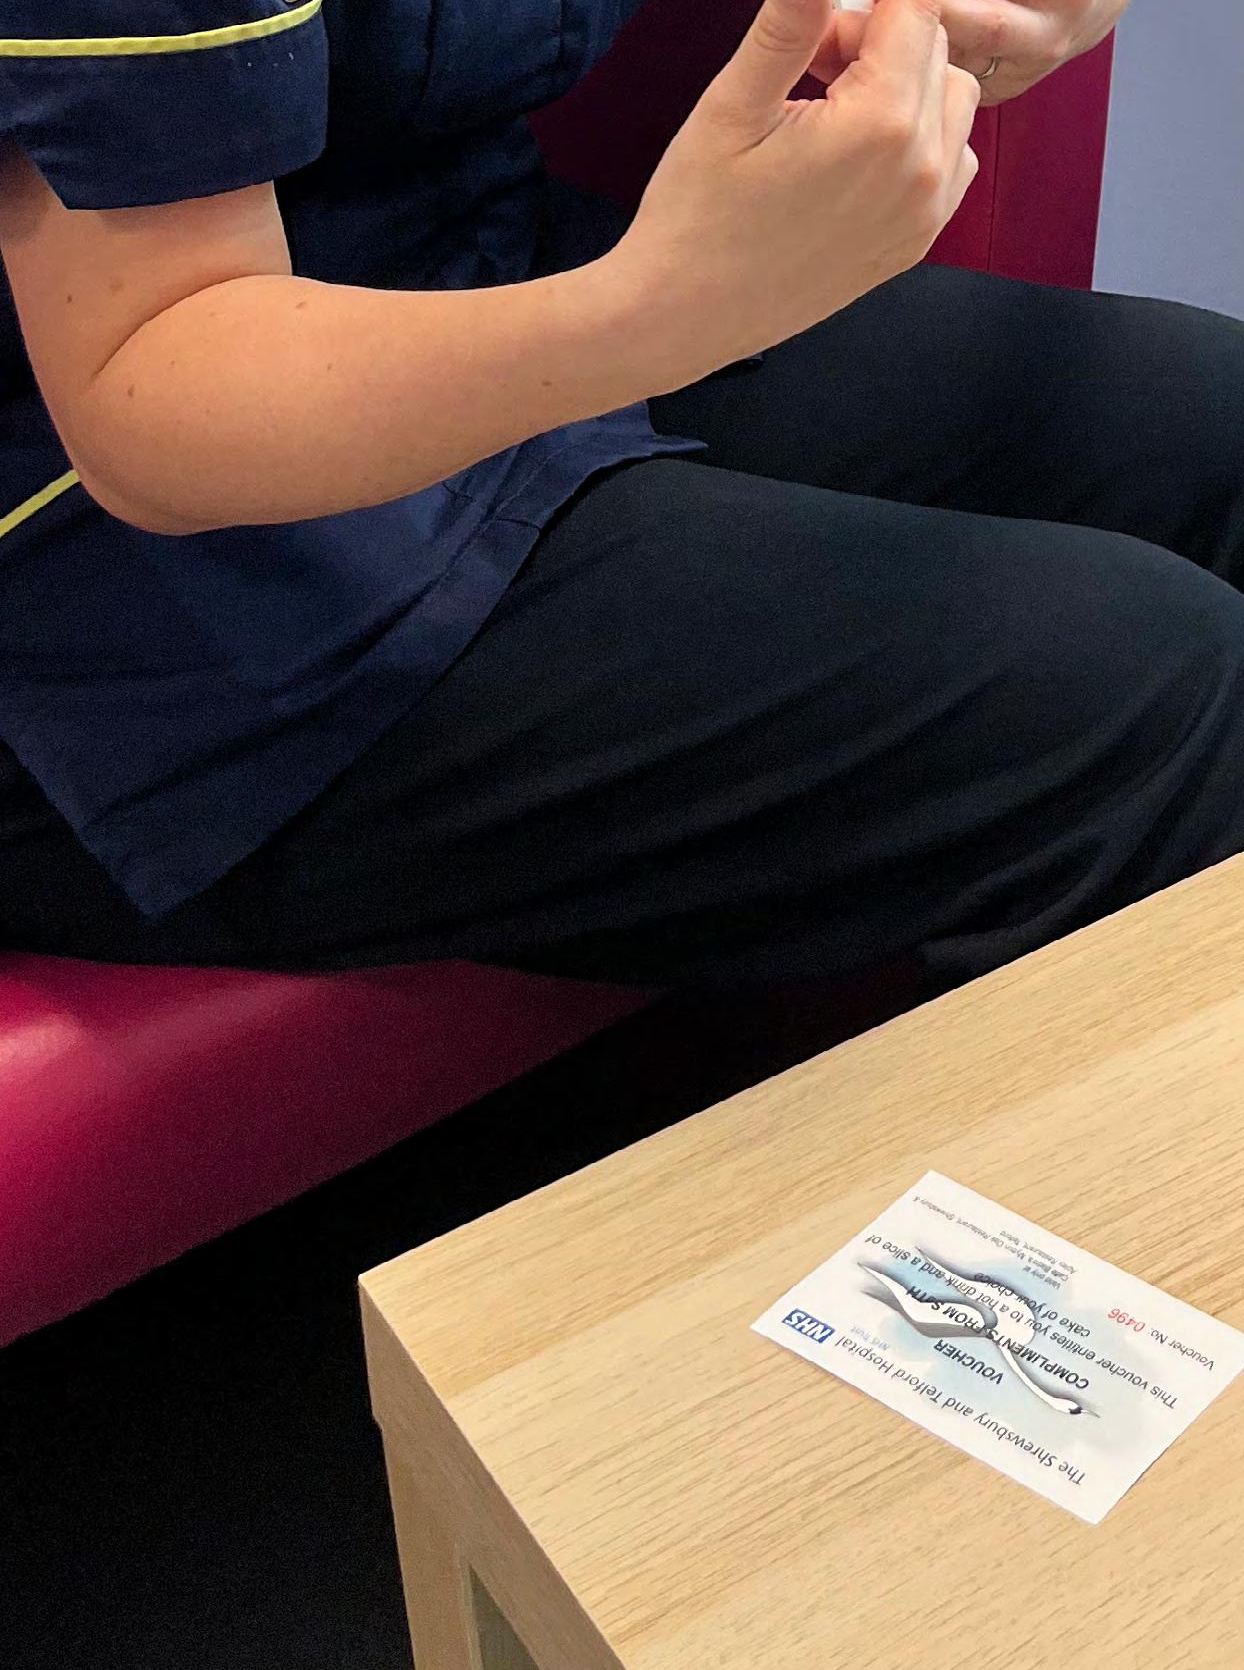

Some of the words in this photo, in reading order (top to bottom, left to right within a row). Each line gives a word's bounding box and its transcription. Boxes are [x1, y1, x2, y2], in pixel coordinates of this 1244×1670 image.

[862, 1231, 884, 1248] of
[878, 1240, 912, 1264] slice
[908, 1255, 923, 1267] a
[917, 1260, 948, 1283] and
[941, 1274, 978, 1299] drink
[969, 1269, 1017, 1300] choice
[972, 1290, 1000, 1311] hot
[996, 1302, 1012, 1315] a
[1012, 1289, 1048, 1314] your
[782, 1307, 835, 1344] NHS
[941, 1303, 988, 1334] FROM
[1006, 1307, 1027, 1324] to
[1022, 1313, 1054, 1336] you
[1039, 1307, 1060, 1324] of
[1054, 1314, 1093, 1341] cake
[1105, 1305, 1148, 1334] 0496
[1046, 1329, 1098, 1364] entitles
[1143, 1325, 1170, 1345] No.
[832, 1333, 897, 1374] Hospital
[931, 1337, 1007, 1385] VOUCHER
[983, 1326, 1092, 1391] COMPLIMENTS
[1164, 1337, 1218, 1372] Voucher
[889, 1366, 946, 1404] Telford
[1093, 1354, 1151, 1392] voucher
[940, 1395, 976, 1421] and
[1145, 1384, 1181, 1409] This
[968, 1410, 1061, 1468] Shrewsbury
[1052, 1459, 1089, 1486] The
